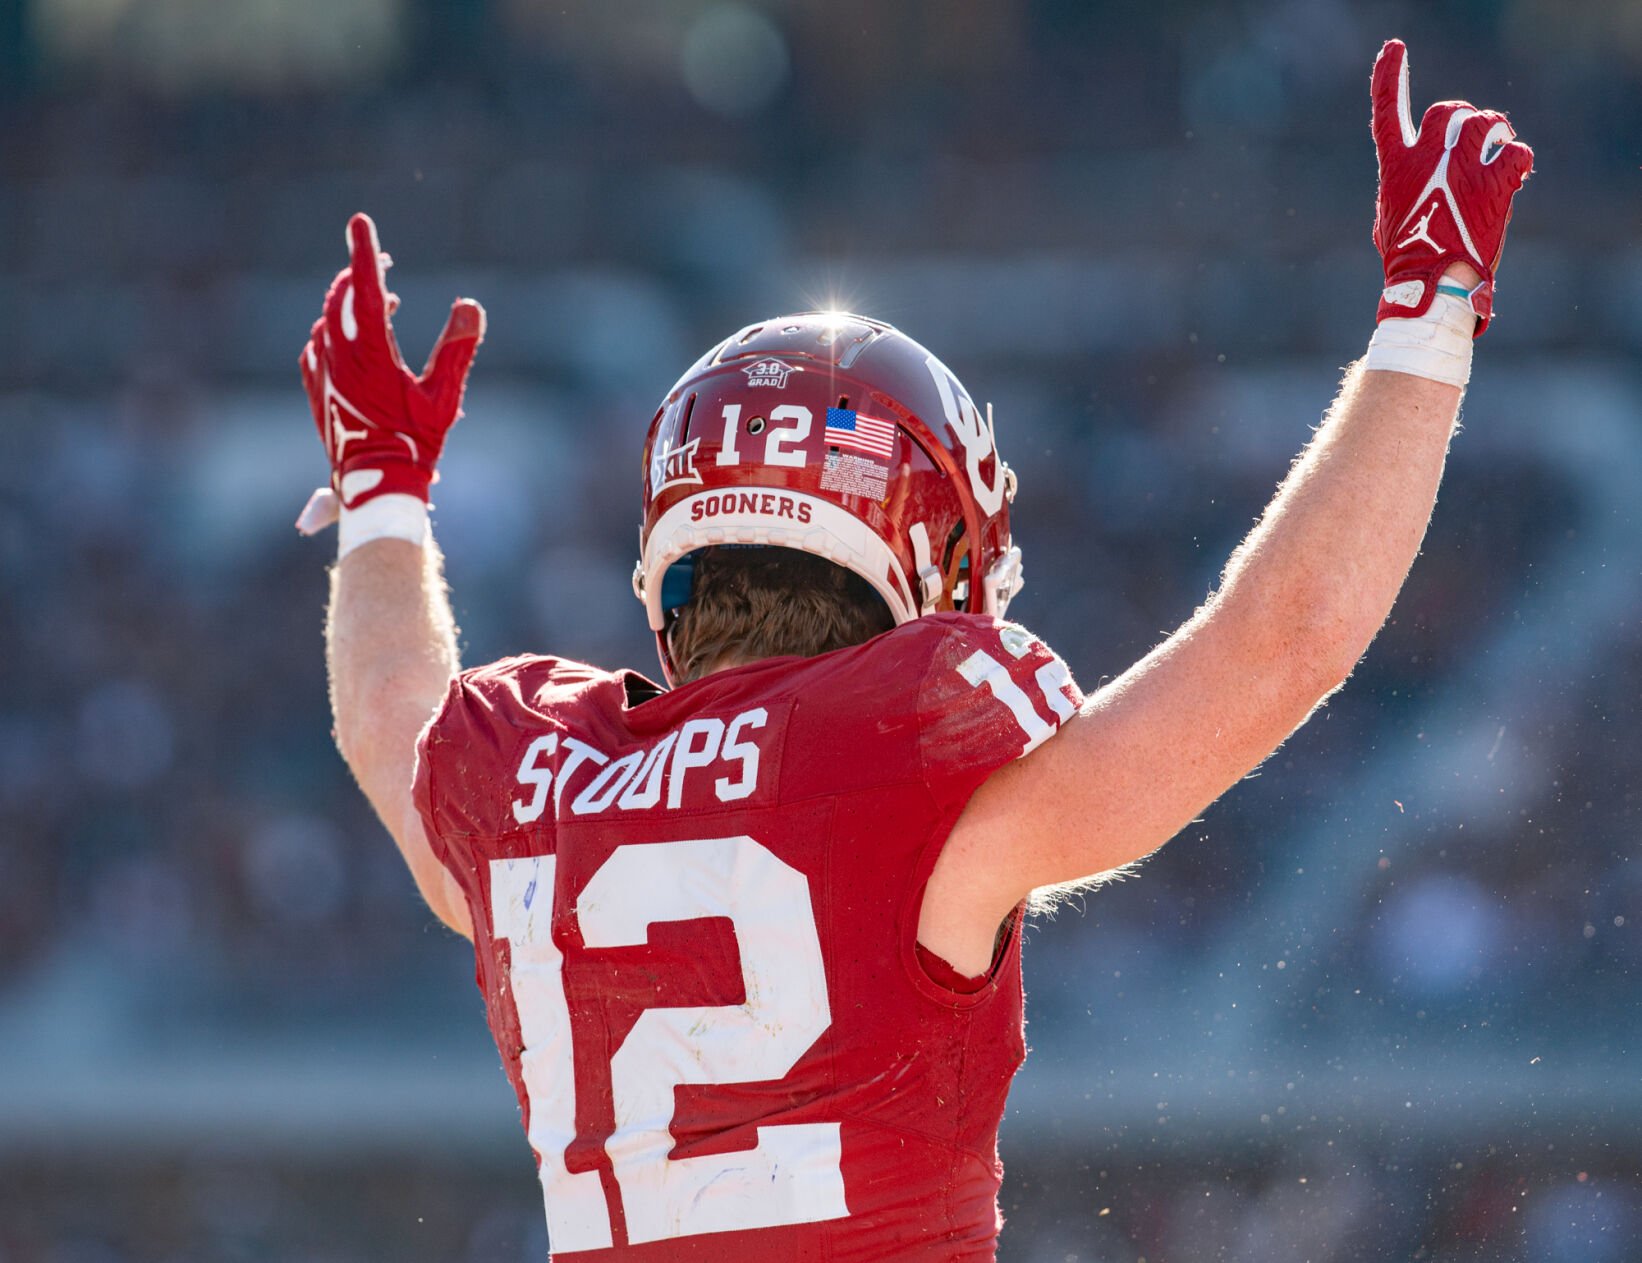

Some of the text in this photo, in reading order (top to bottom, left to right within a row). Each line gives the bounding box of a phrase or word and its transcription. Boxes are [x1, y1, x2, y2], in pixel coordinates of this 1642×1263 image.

[748, 378, 778, 387] GRAD
[716, 404, 813, 467] 12
[842, 454, 875, 465] WARNING
[691, 493, 812, 523] SOONERS
[512, 707, 768, 824] STOOPS
[489, 835, 851, 1254] 12
